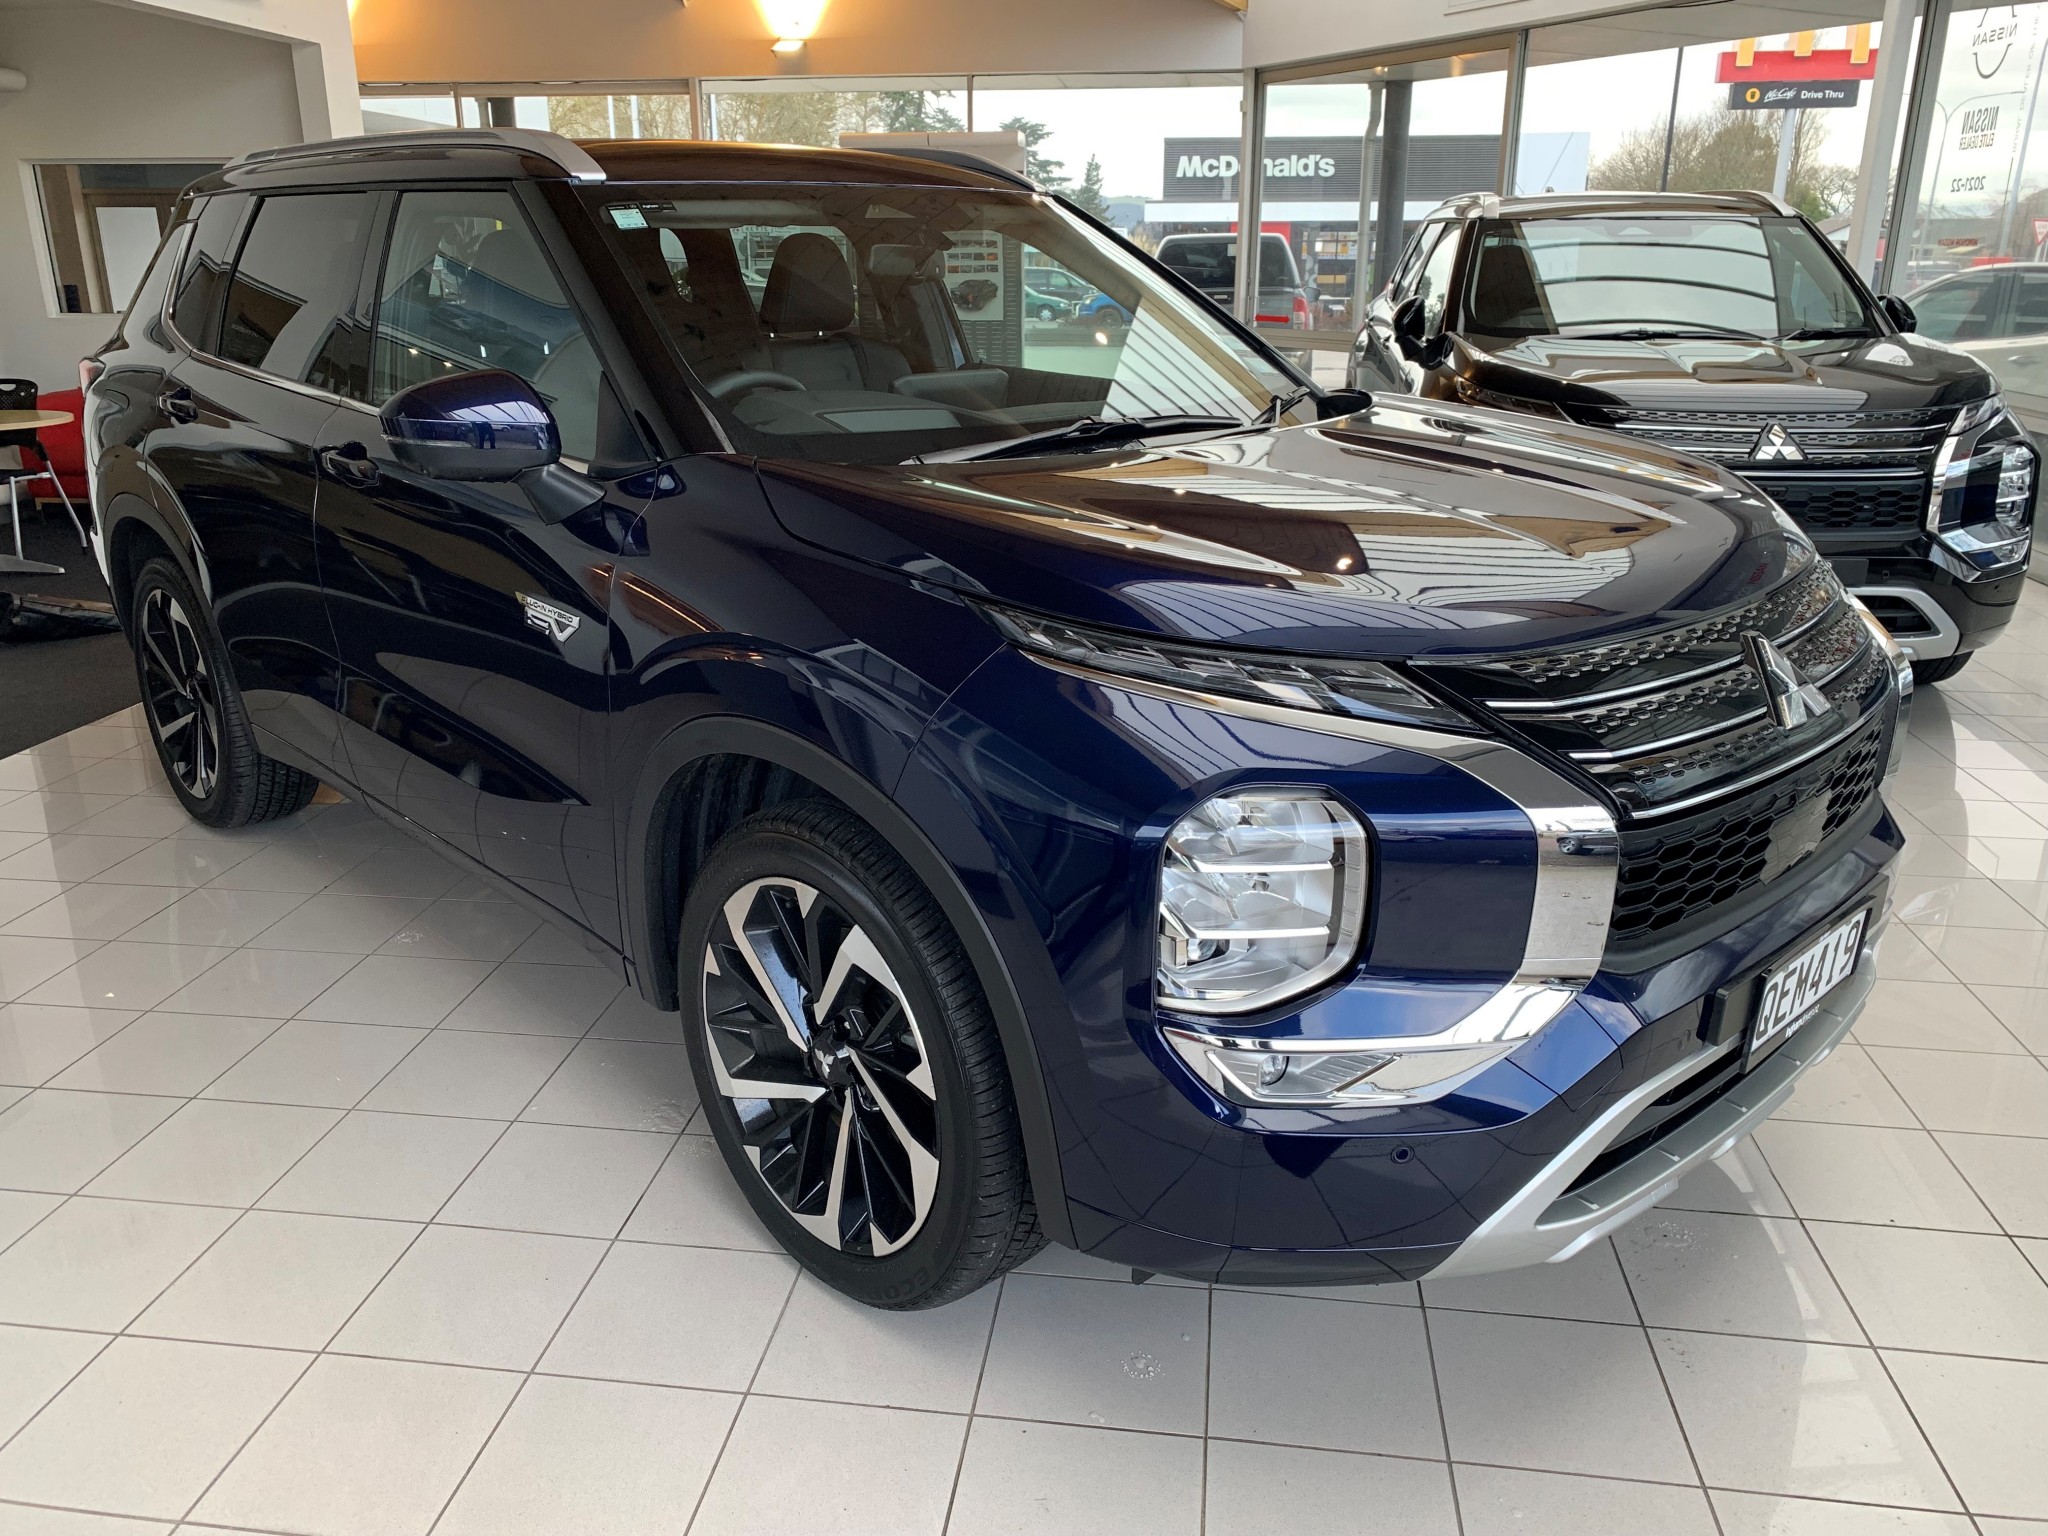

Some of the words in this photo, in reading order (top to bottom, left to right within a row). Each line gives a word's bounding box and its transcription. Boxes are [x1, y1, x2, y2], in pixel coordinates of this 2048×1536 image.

[1801, 90, 1824, 99] Drive
[1824, 90, 1845, 98] Thru
[1176, 154, 1335, 177] McDnald's
[547, 608, 574, 623] HYBRID
[1755, 918, 1861, 1042] QEM419
